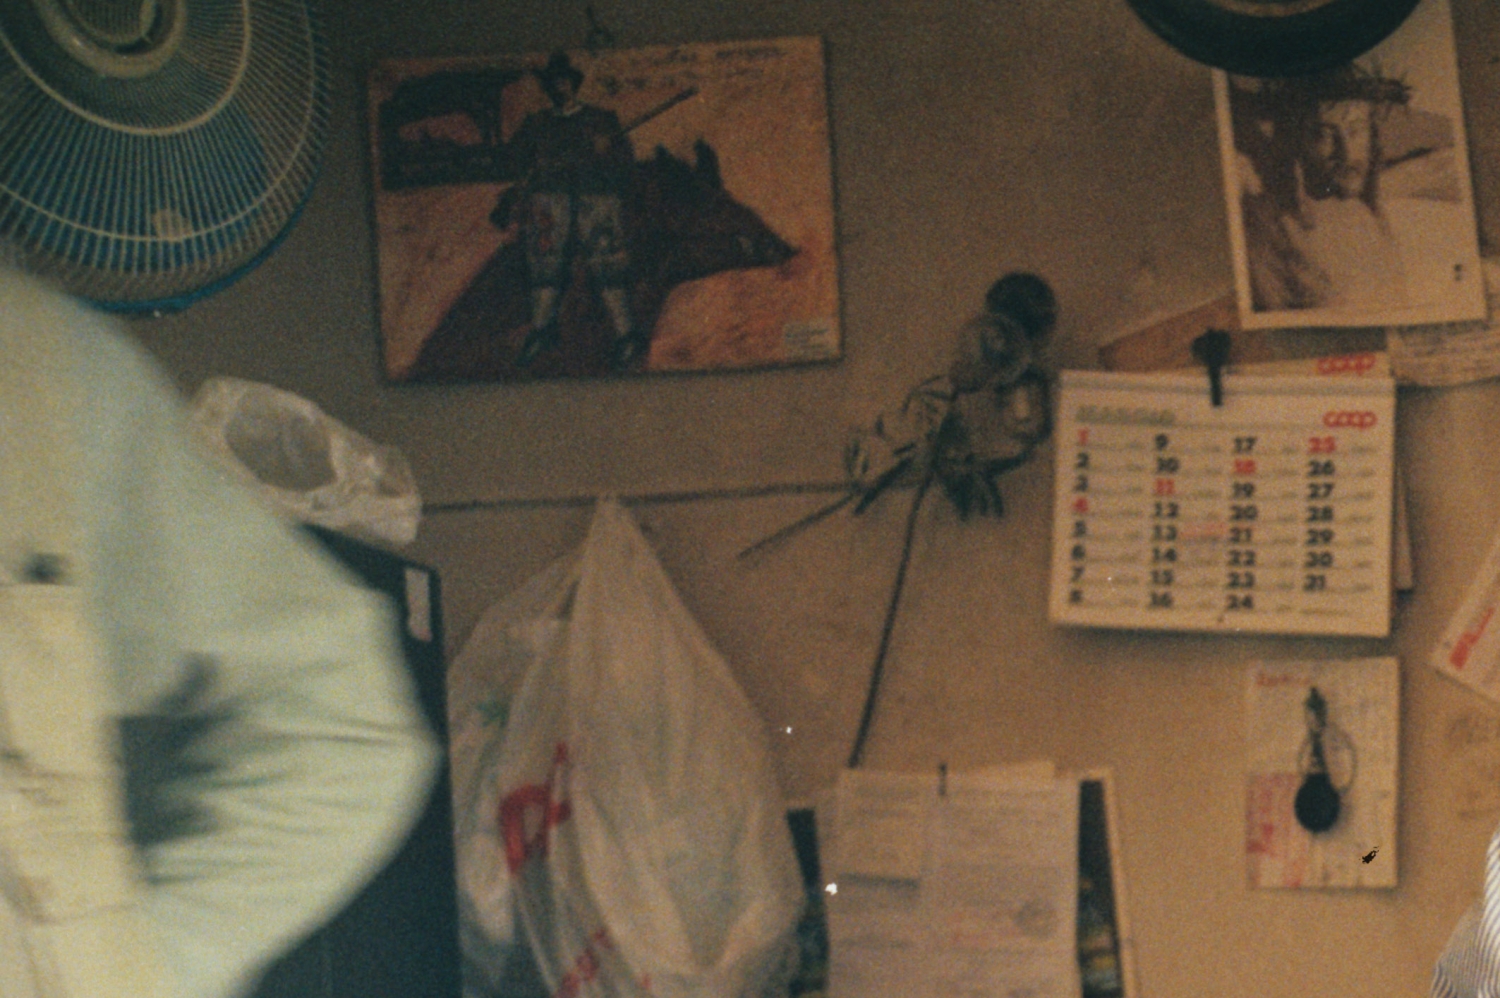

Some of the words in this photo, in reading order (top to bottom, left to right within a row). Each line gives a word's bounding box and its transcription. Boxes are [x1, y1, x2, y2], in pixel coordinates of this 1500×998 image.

[1322, 411, 1377, 430] coop
[1154, 434, 1169, 451] 9
[1234, 436, 1257, 453] 17
[1308, 436, 1336, 454] 25
[1076, 452, 1090, 470] 2
[1156, 456, 1180, 474] 10
[1308, 460, 1336, 477] 26
[1232, 482, 1256, 499] 19
[1308, 482, 1334, 500] 27
[1154, 502, 1179, 519] 12
[1230, 505, 1258, 522] 20
[1306, 505, 1334, 522] 28
[1229, 526, 1252, 544] 21
[1306, 528, 1334, 546] 29
[1071, 544, 1086, 562] 6
[1152, 548, 1178, 564] 14
[1228, 550, 1256, 568] 22
[1305, 550, 1333, 568] 30
[1071, 566, 1085, 582] 7
[1226, 594, 1254, 610] 24
